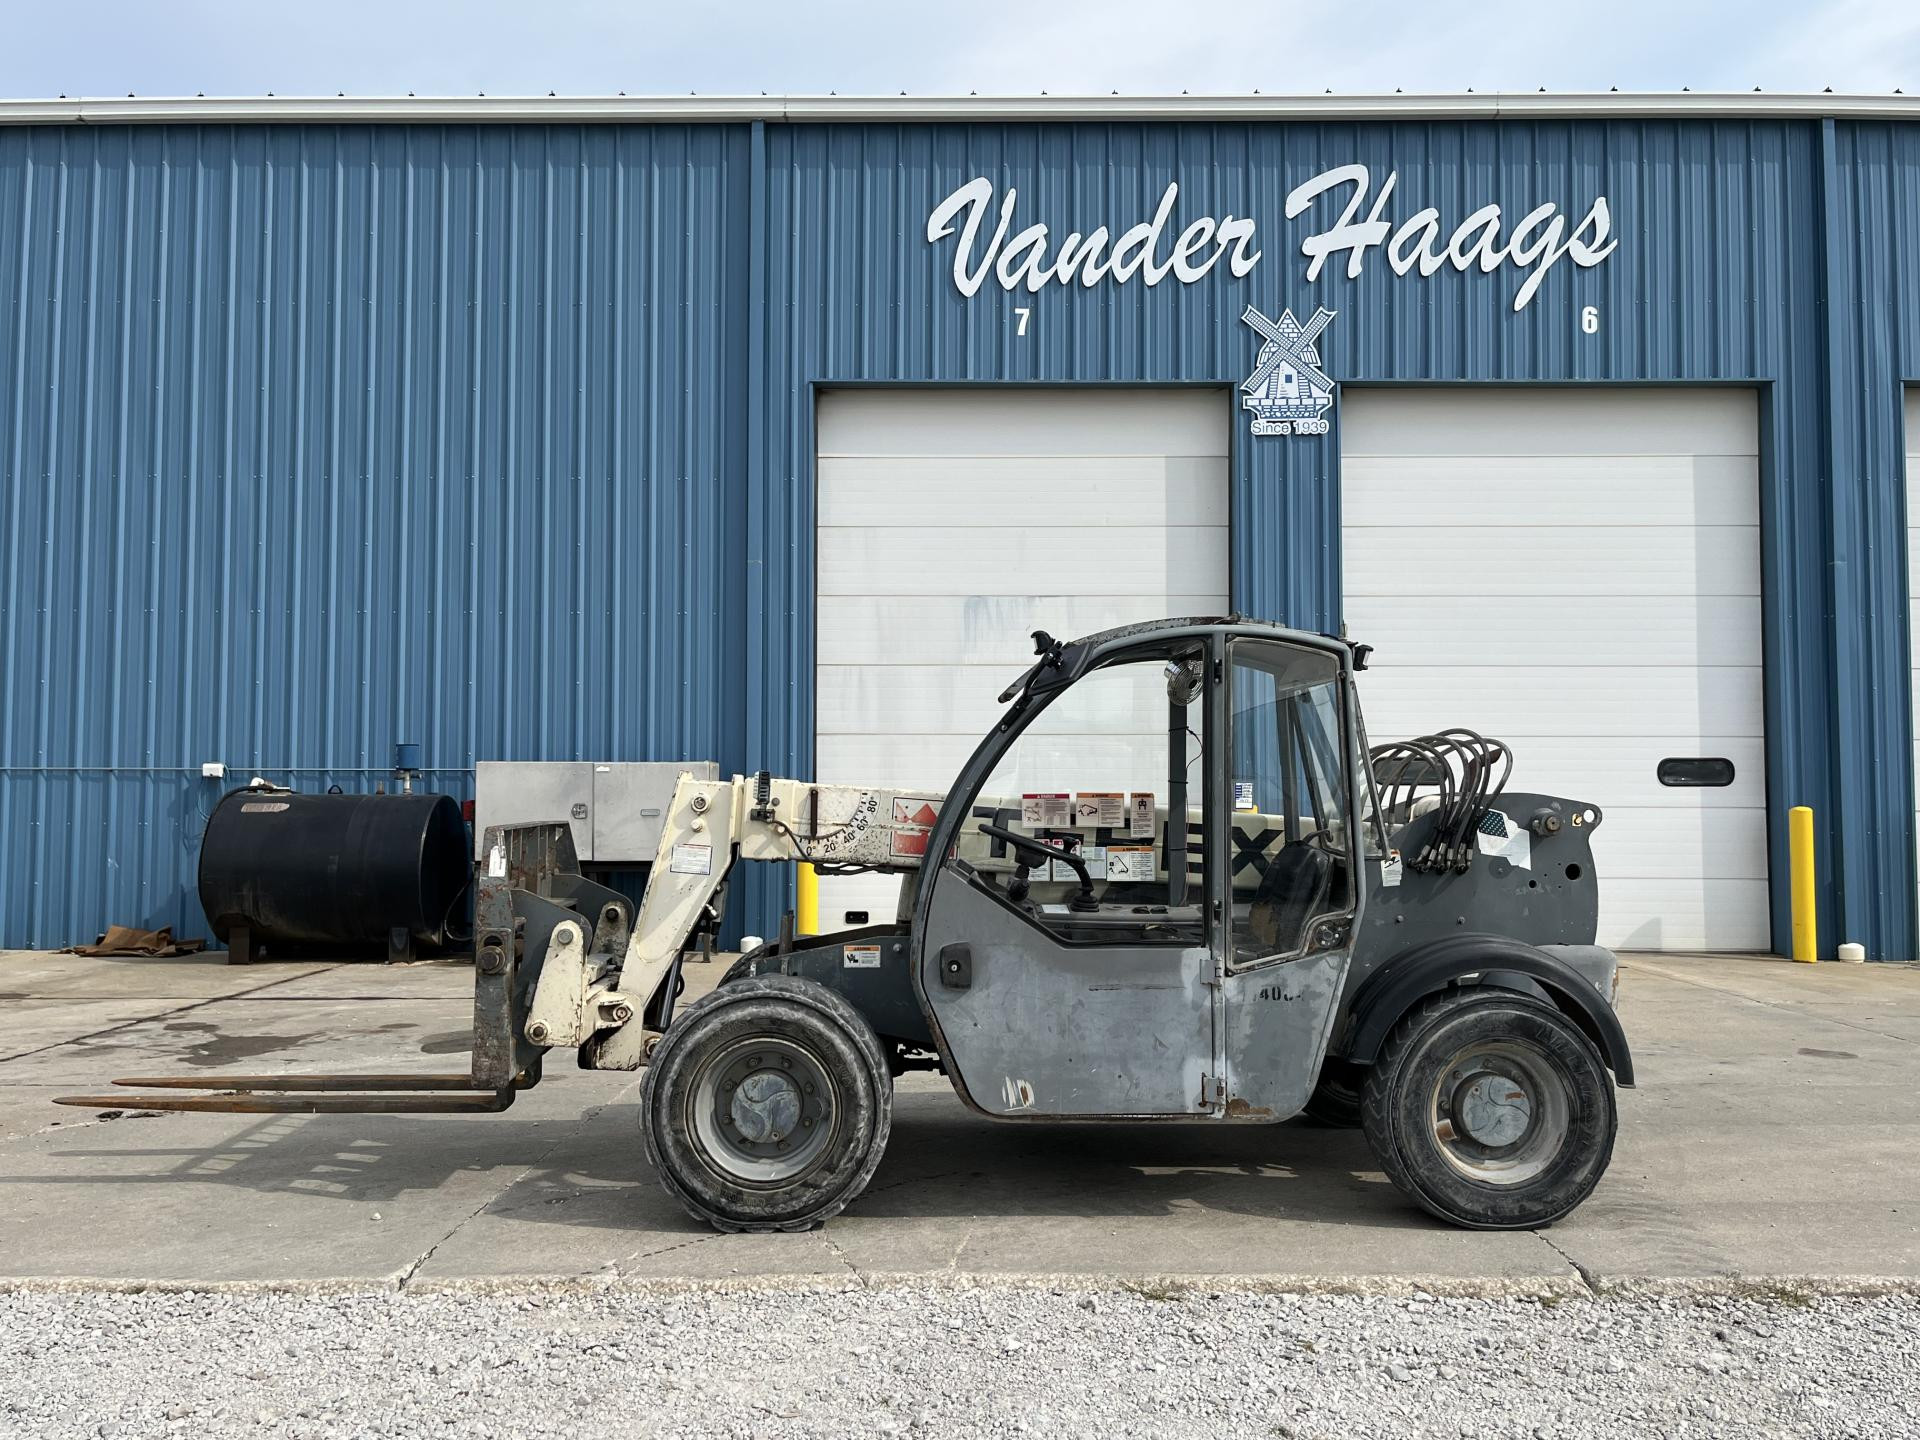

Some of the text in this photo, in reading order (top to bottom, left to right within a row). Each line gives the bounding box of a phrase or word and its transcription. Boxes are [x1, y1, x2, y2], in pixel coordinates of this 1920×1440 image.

[928, 164, 1618, 312] Vander Haags
[1014, 308, 1030, 336] 7
[1582, 306, 1599, 334] 6
[1251, 421, 1327, 434] Since 1939
[973, 805, 1284, 877] TEX
